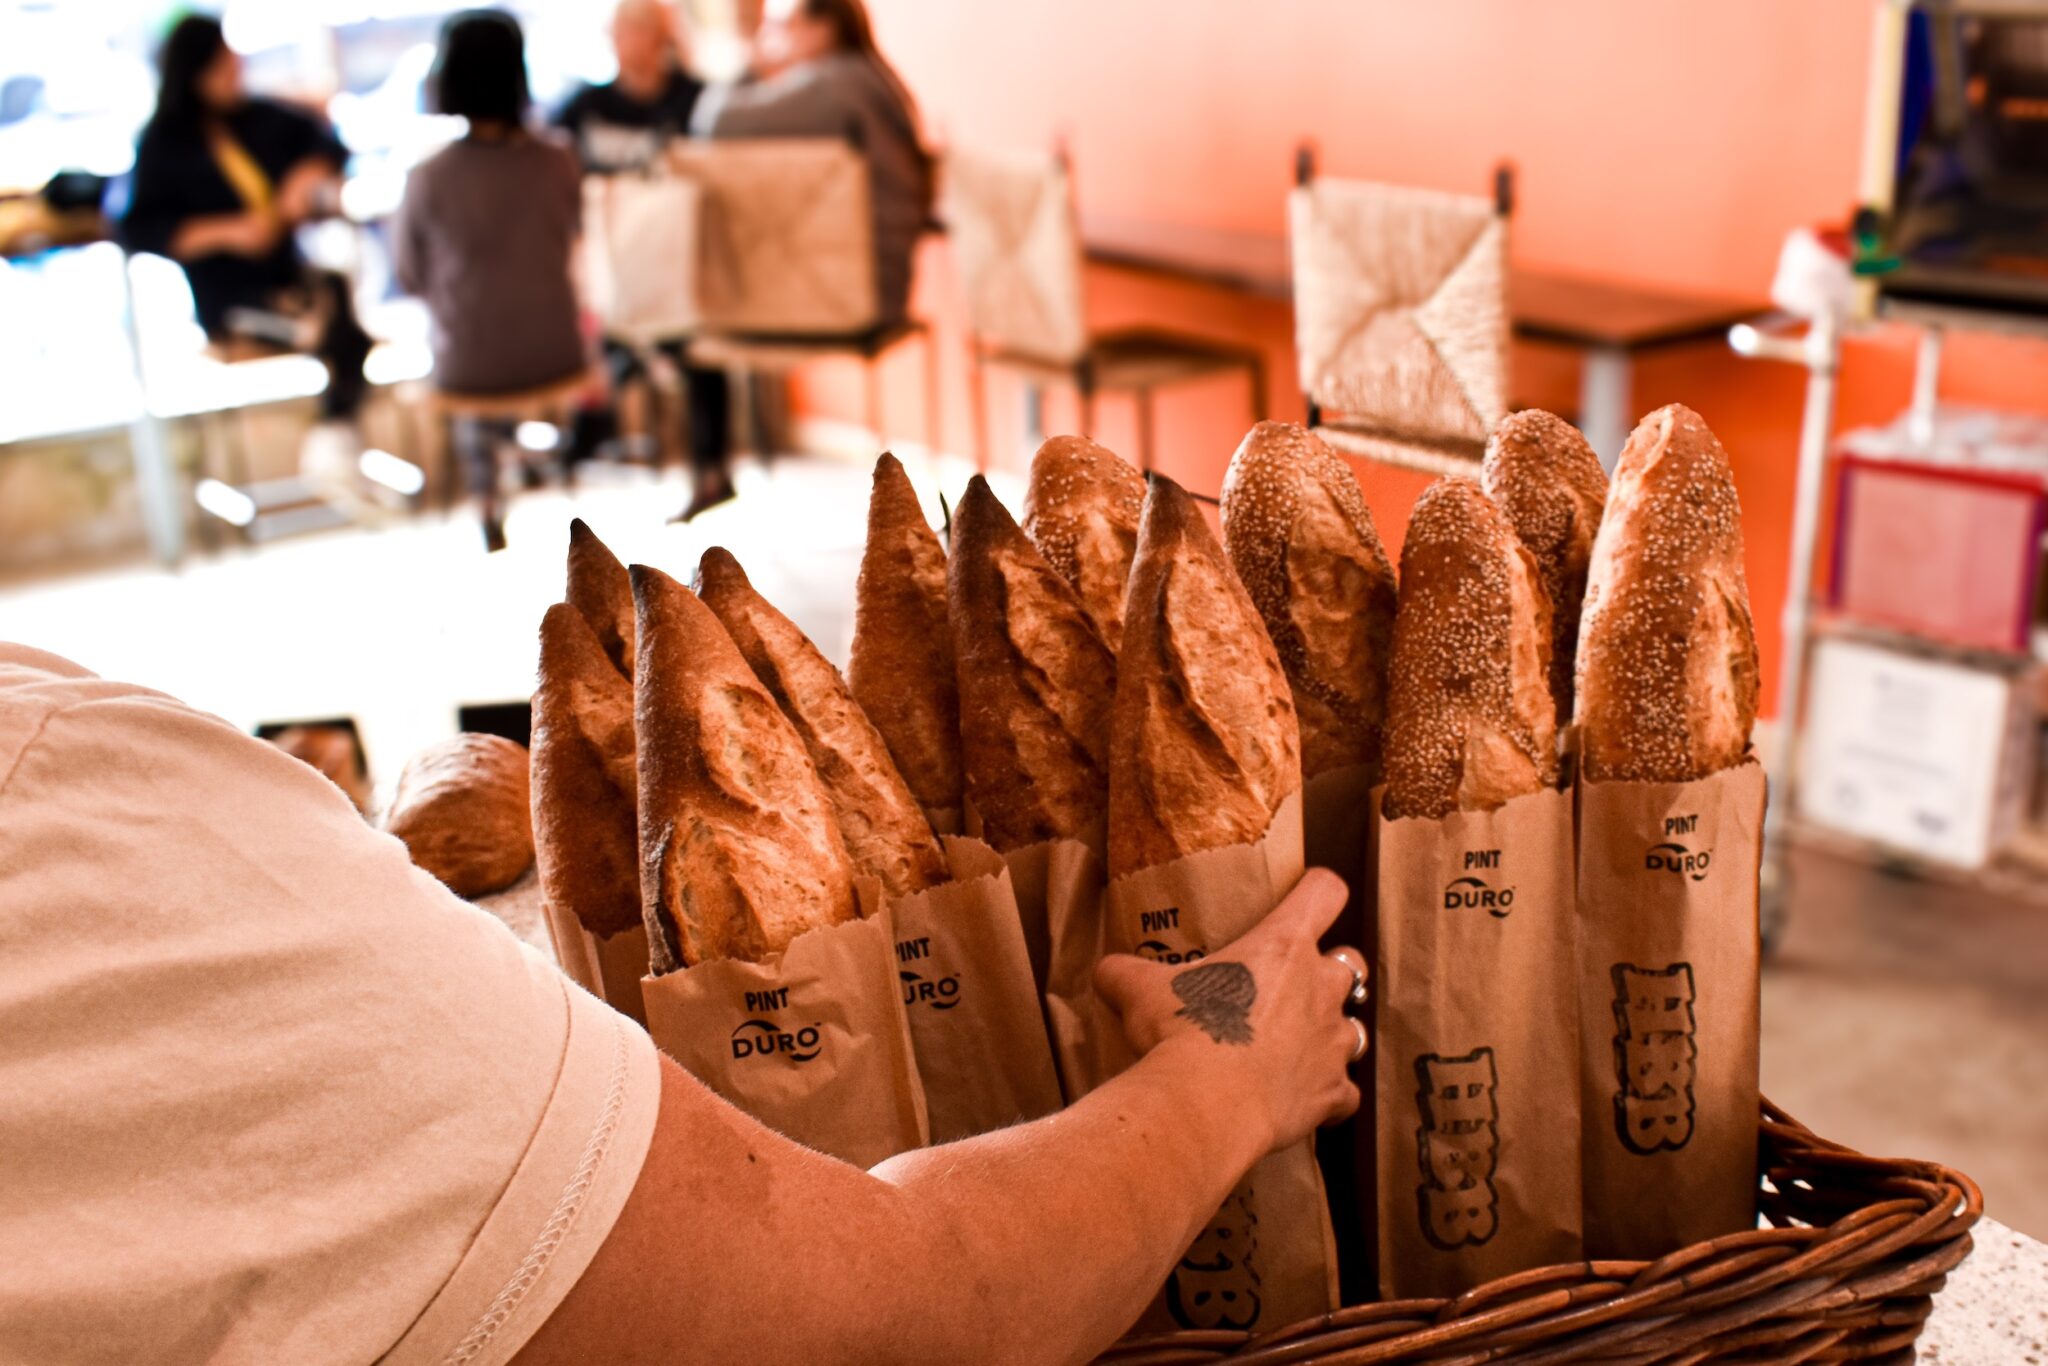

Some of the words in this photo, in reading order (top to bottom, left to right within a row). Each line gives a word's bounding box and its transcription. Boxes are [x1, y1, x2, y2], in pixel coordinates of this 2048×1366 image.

[1665, 814, 1698, 836] PINT
[1464, 849, 1501, 870] PINT
[1645, 850, 1711, 875] DURO
[1444, 887, 1514, 911] DURO
[1141, 907, 1179, 932] PINT
[896, 937, 930, 962] INT
[745, 987, 789, 1012] PINT
[731, 1026, 820, 1059] DURO
